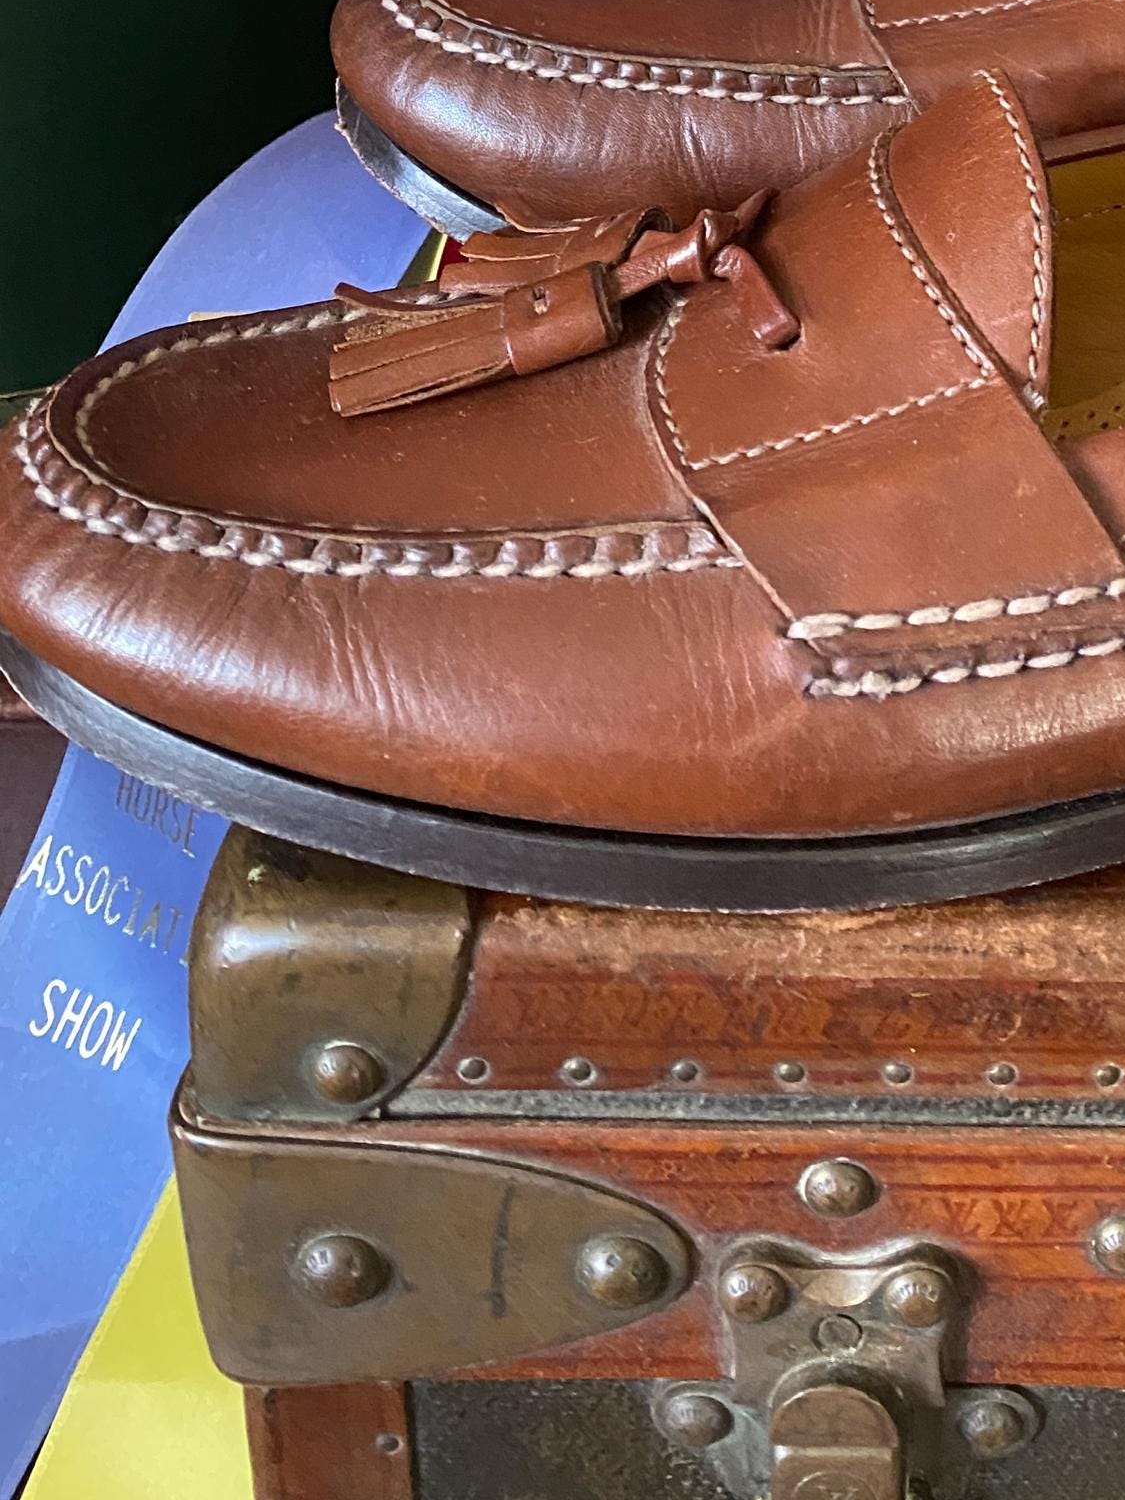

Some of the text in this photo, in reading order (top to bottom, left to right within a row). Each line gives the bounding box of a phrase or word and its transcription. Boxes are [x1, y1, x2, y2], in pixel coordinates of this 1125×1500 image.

[115, 773, 197, 858] HORSE
[16, 835, 190, 966] ASSOCIAT
[29, 978, 143, 1072] SHOW
